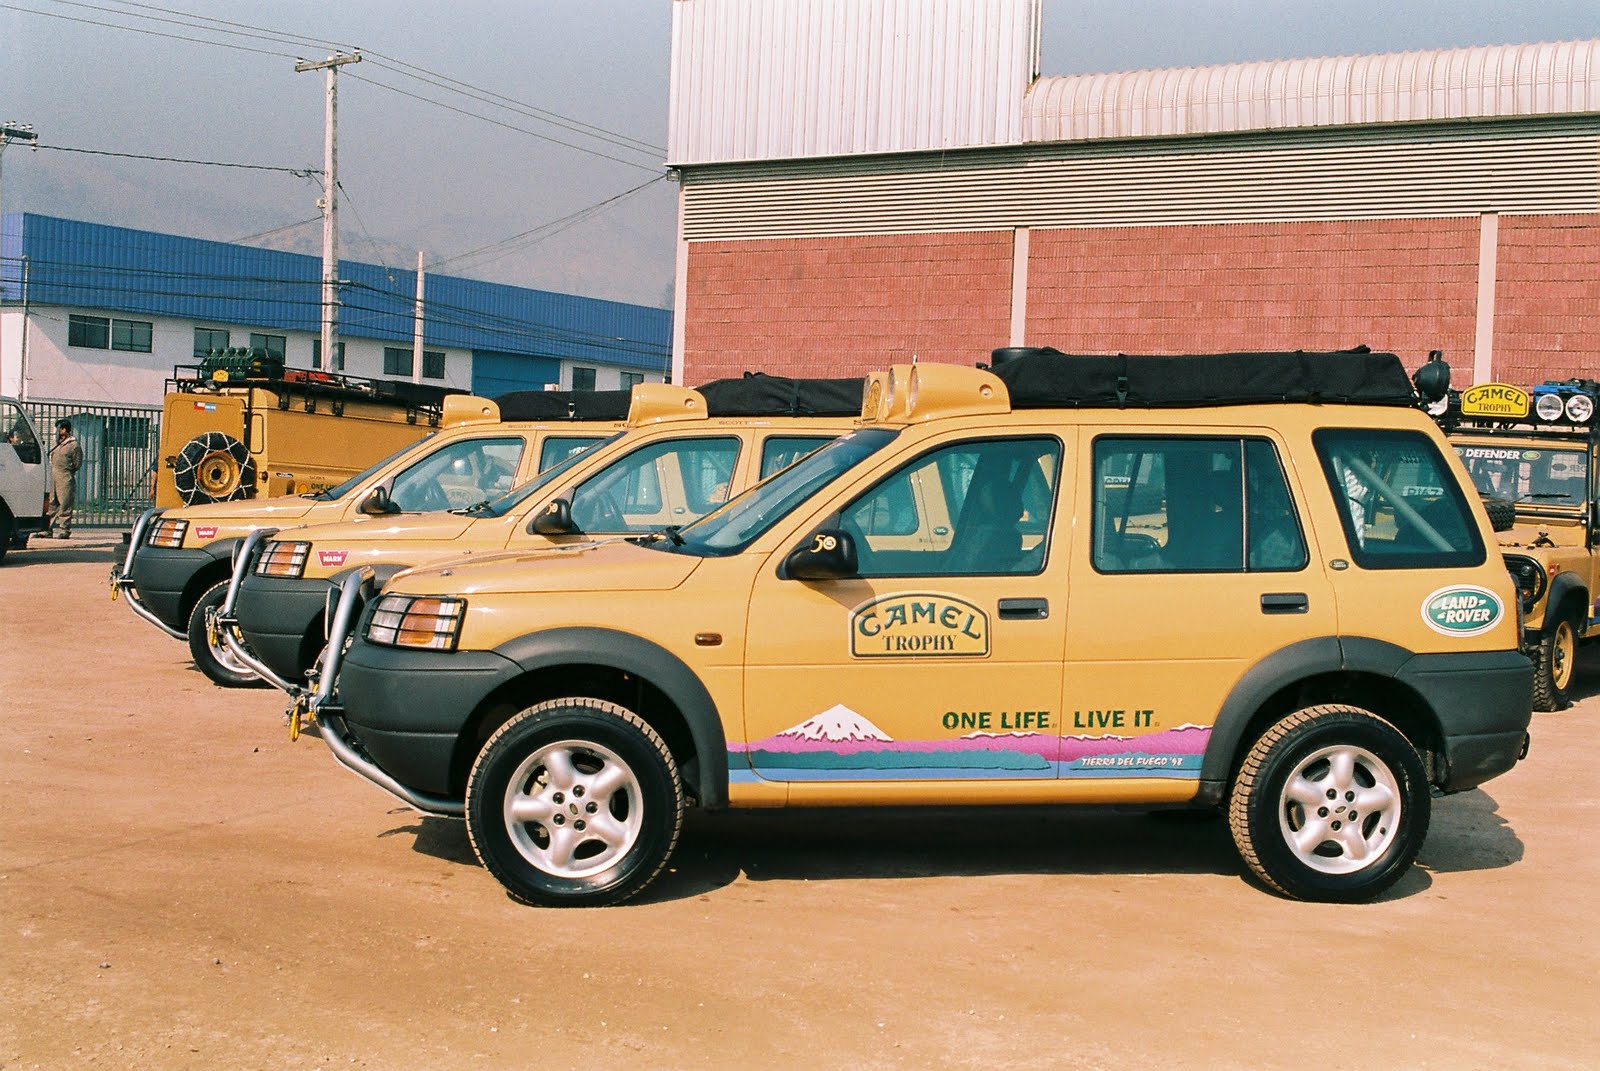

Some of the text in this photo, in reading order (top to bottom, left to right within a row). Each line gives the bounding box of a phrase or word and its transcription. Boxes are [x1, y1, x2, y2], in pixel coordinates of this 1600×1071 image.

[1467, 388, 1523, 407] CAMEL
[1478, 403, 1513, 412] TROPHY
[1465, 448, 1520, 460] DEFENDER
[809, 533, 838, 553] 50
[858, 602, 982, 640] CAMEL
[1445, 608, 1491, 624] ROVER
[882, 634, 958, 651] TROPHY
[942, 711, 992, 729] ONE
[1073, 710, 1126, 728] LIVE
[1081, 757, 1116, 767] TIERRA
[1117, 757, 1134, 766] DEL
[1136, 757, 1168, 766] FUEGO
